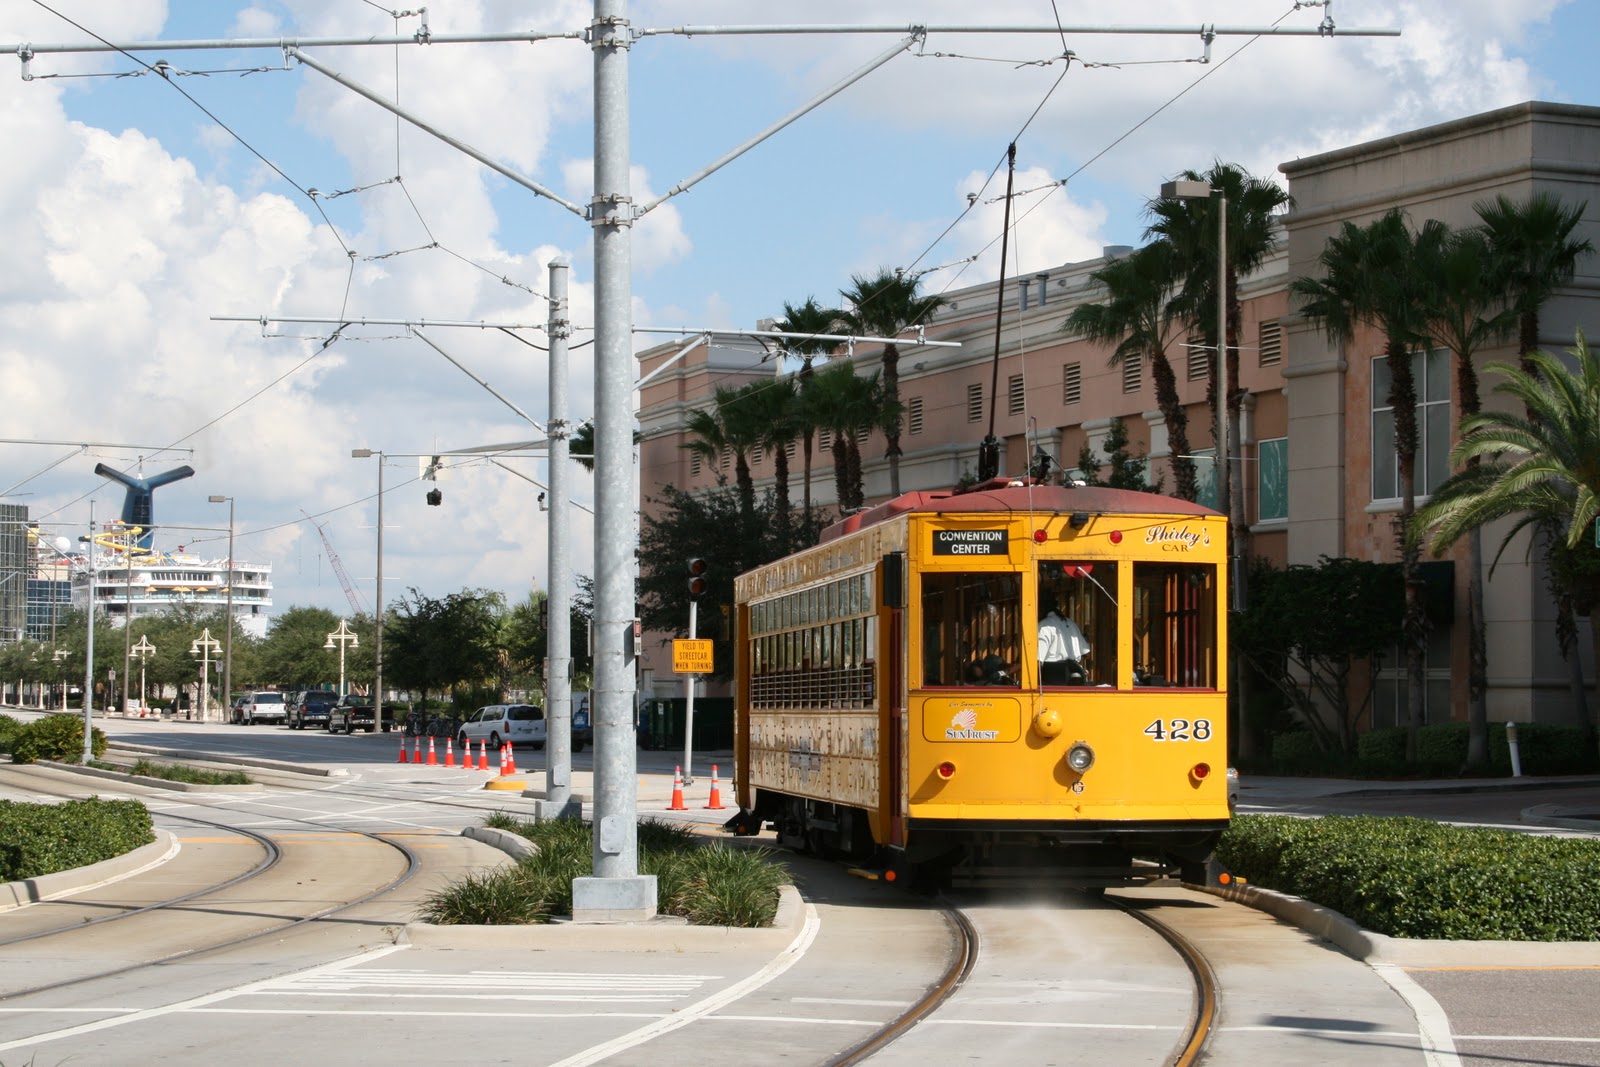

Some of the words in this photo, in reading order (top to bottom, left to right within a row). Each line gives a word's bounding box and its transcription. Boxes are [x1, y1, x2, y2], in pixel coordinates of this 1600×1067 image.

[940, 531, 1002, 541] CONVENTION
[1145, 525, 1210, 548] Shirley's
[951, 544, 990, 554] CENTER
[1161, 544, 1189, 552] CAR
[682, 642, 696, 650] YIELD
[698, 642, 705, 650] TO
[679, 652, 707, 660] STREETCAR
[675, 662, 689, 670] WHEN
[691, 662, 712, 670] TURNING
[1143, 718, 1212, 741] 428
